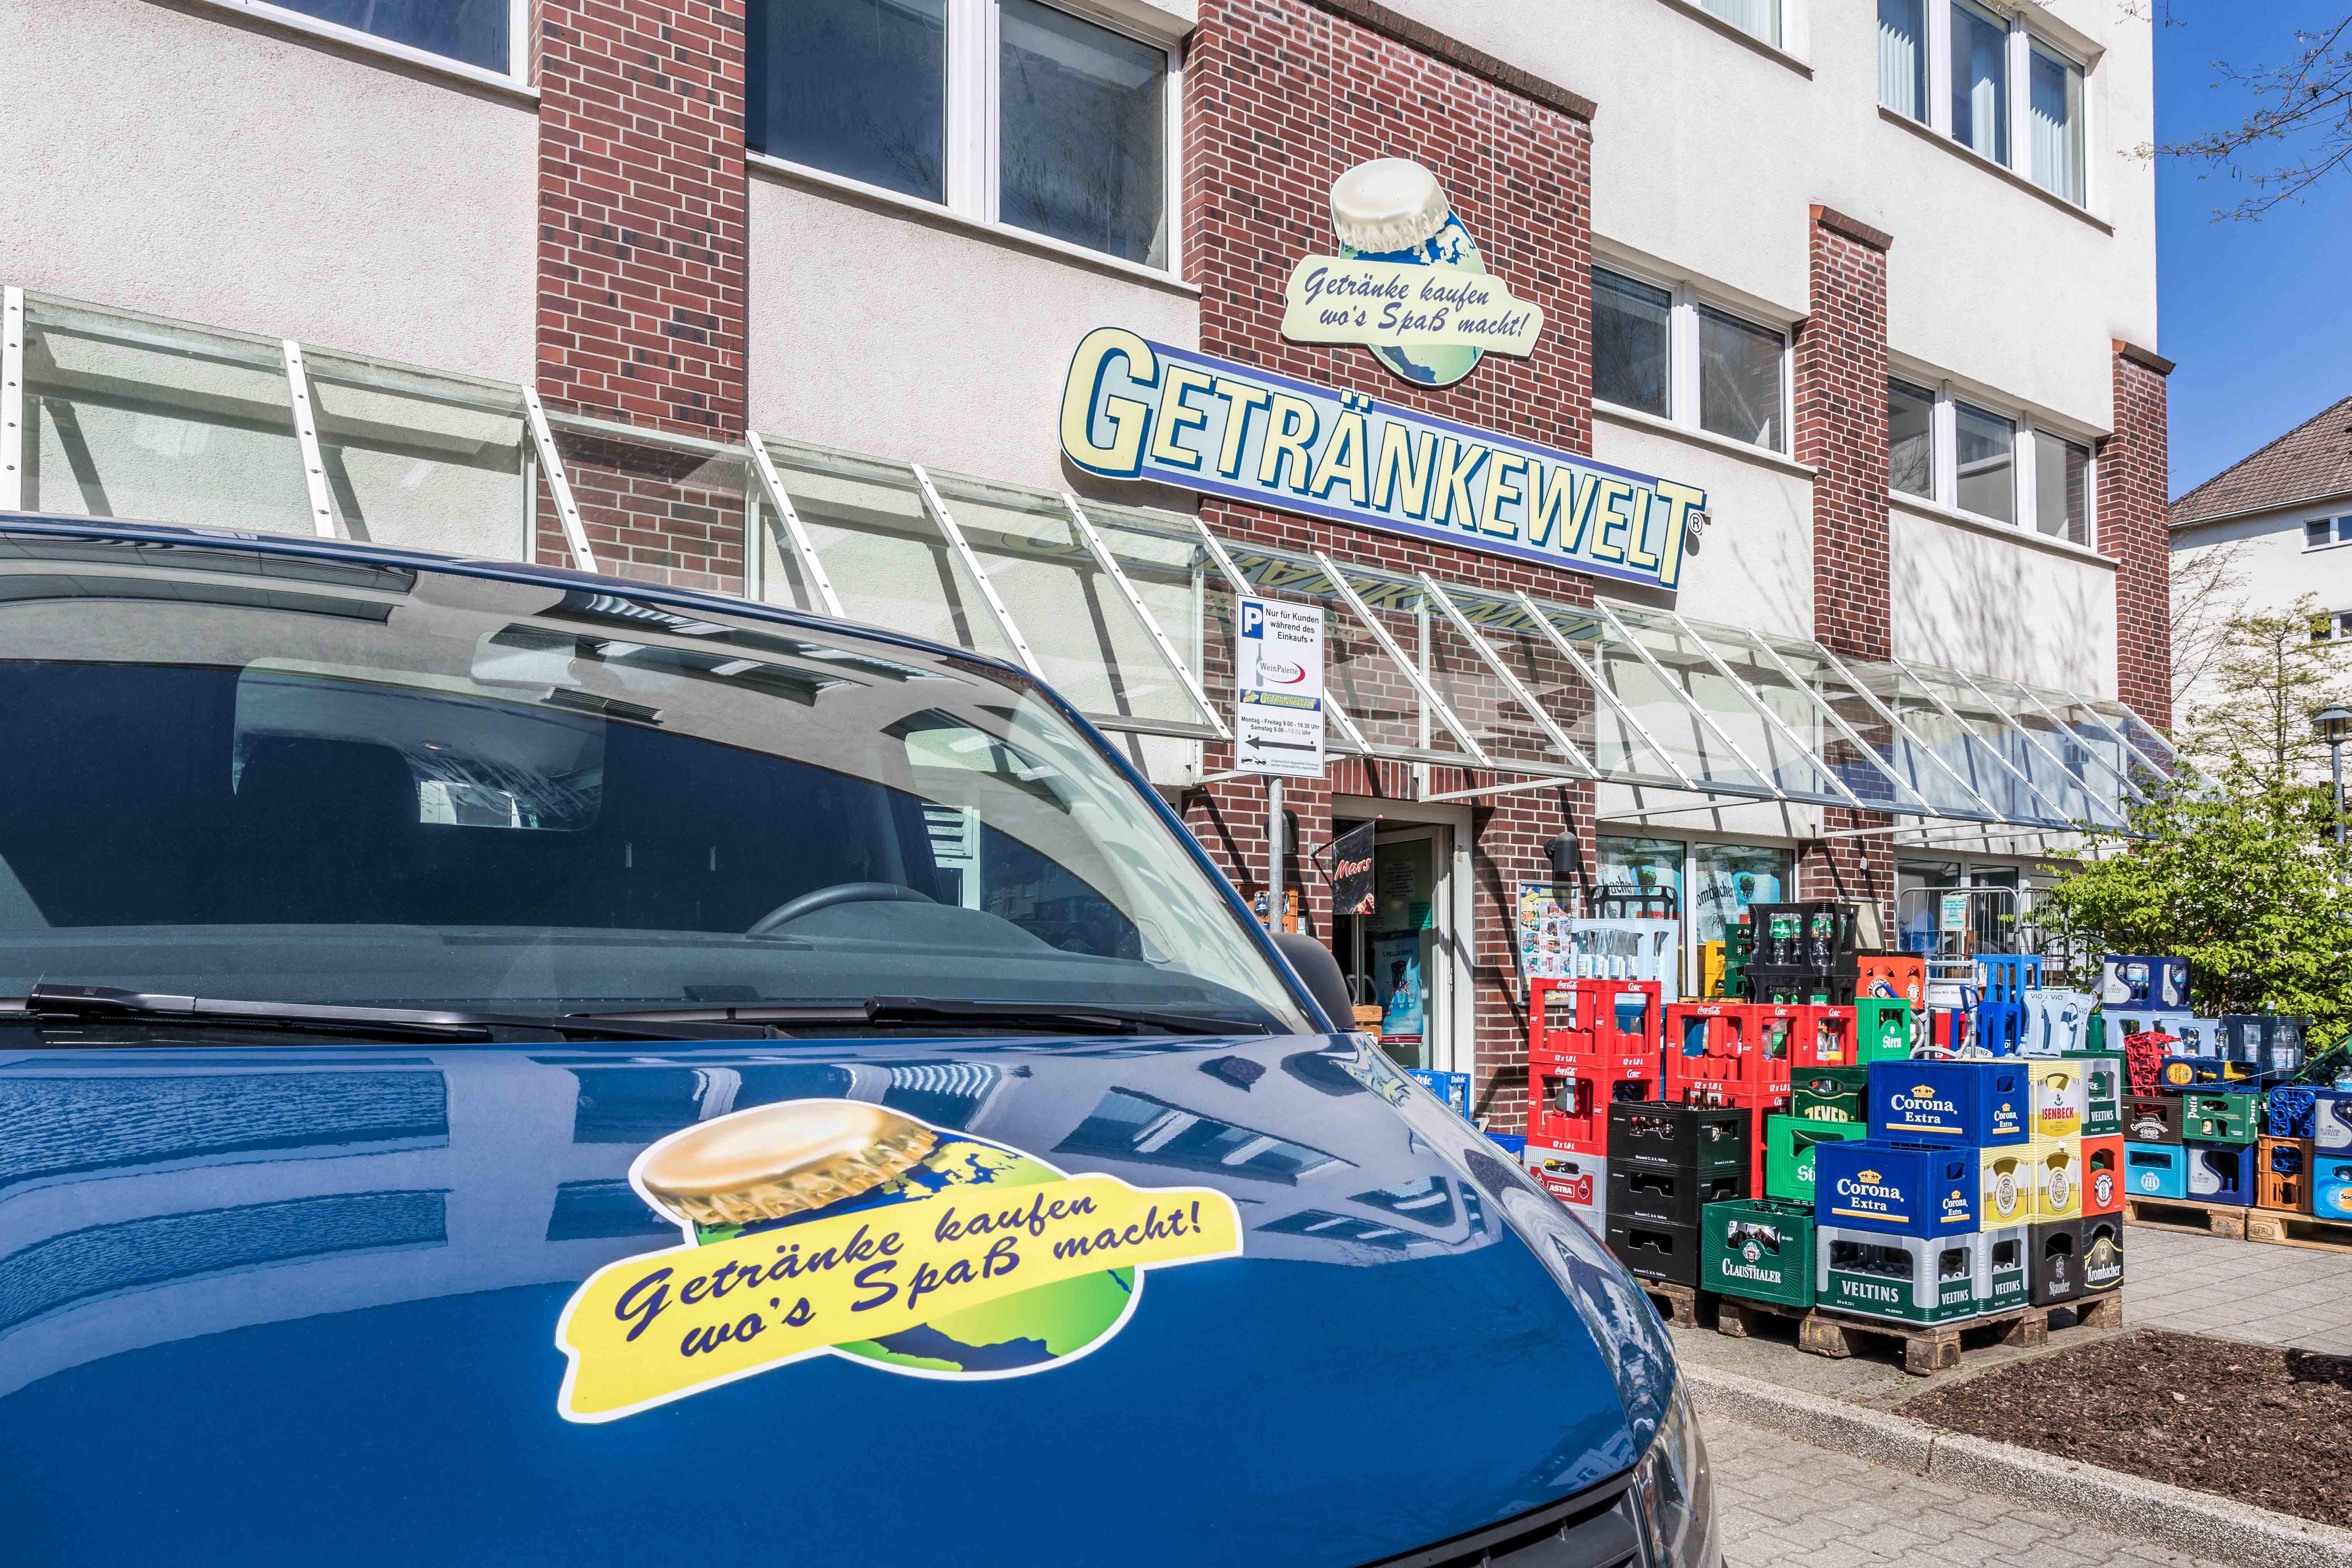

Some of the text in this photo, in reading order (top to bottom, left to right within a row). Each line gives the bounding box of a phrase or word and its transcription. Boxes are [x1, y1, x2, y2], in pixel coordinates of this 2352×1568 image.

[1305, 267, 1489, 312] Getränke kaufen
[1320, 302, 1530, 337] wo's Spaß macht!
[1060, 327, 1705, 590] GETRÄNKEWELT
[1244, 606, 1263, 633] P
[1266, 609, 1319, 624] Nur für Kunden
[1270, 621, 1300, 631] während
[1278, 632, 1308, 643] Einkaufs
[1260, 663, 1298, 675] WeinPalette
[1260, 692, 1316, 709] GETRÄNKEWELT
[1334, 858, 1371, 881] Mars
[1628, 983, 1642, 991] Coke
[1775, 1006, 1787, 1015] Coke
[1829, 1008, 1841, 1017] Coke
[1883, 1035, 1902, 1048] Stern
[1627, 1069, 1641, 1078] Coke
[1891, 1094, 1955, 1112] Corona
[2188, 1096, 2200, 1119] Pott's
[1905, 1111, 1941, 1124] Extra
[1994, 1111, 2017, 1121] Corona
[2042, 1107, 2074, 1120] ISENBECK
[2091, 1110, 2114, 1121] VELTINS
[2130, 1121, 2168, 1133] Grevensteiner
[1549, 1184, 1572, 1194] ASTRA
[1837, 1179, 1901, 1199] Corona
[2095, 1174, 2112, 1189] ERDINGER
[1851, 1197, 1887, 1211] Extra
[1943, 1198, 1967, 1209] Corona
[2254, 1226, 2270, 1235] EPAL
[615, 1192, 1097, 1342] Getränke kaufen
[1723, 1258, 1781, 1284] CLAUSTHALER
[2088, 1262, 2120, 1282] Krombacher
[681, 1201, 1202, 1357] wo's Spaß macht!
[1841, 1280, 1899, 1302] VELTINS
[1995, 1280, 2020, 1295] VELTINS
[2049, 1279, 2070, 1296] Stauder
[1941, 1289, 1968, 1305] VELTINS
